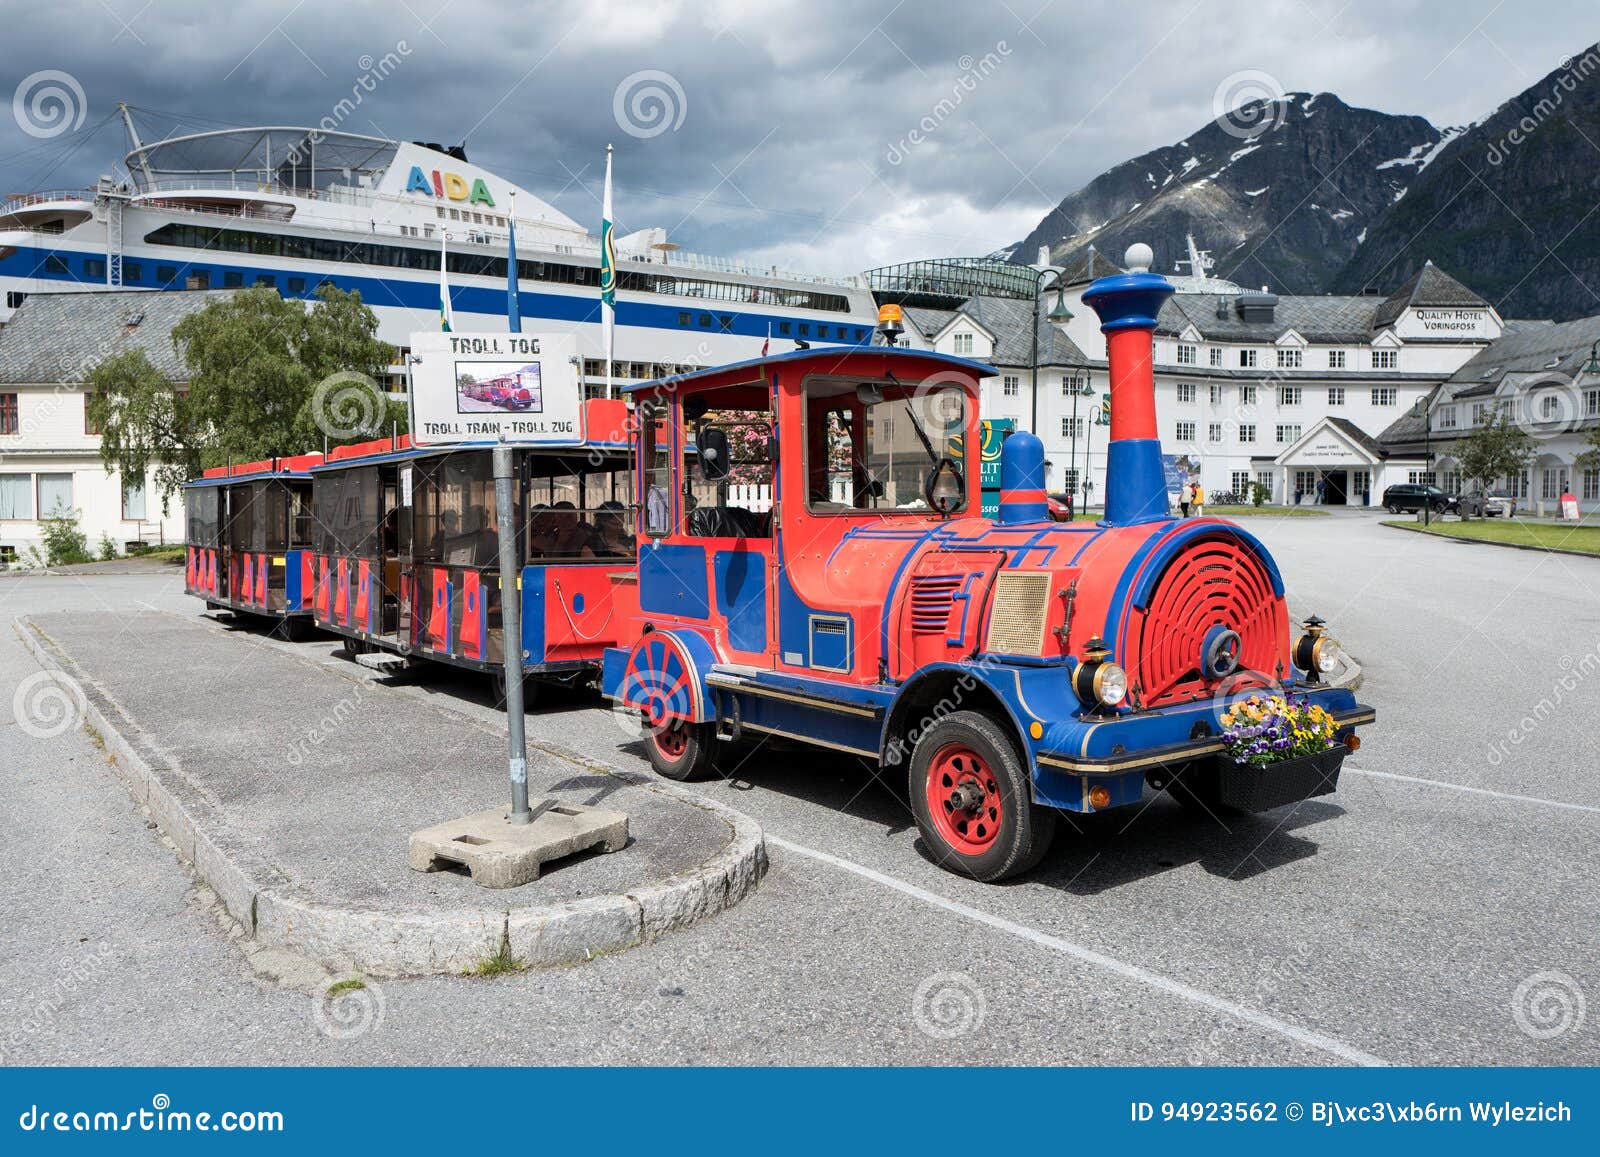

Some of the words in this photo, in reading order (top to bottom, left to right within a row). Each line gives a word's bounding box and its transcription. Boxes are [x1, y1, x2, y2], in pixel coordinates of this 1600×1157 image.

[406, 166, 496, 207] AIDA
[1416, 309, 1452, 320] QUALITY
[1455, 309, 1483, 320] HOTEL
[449, 337, 504, 354] TROLL
[509, 338, 541, 354] TOG
[424, 422, 463, 434] TROLL
[467, 422, 500, 434] TRAIN
[511, 421, 548, 434] TROLL
[551, 421, 573, 433] ZUG
